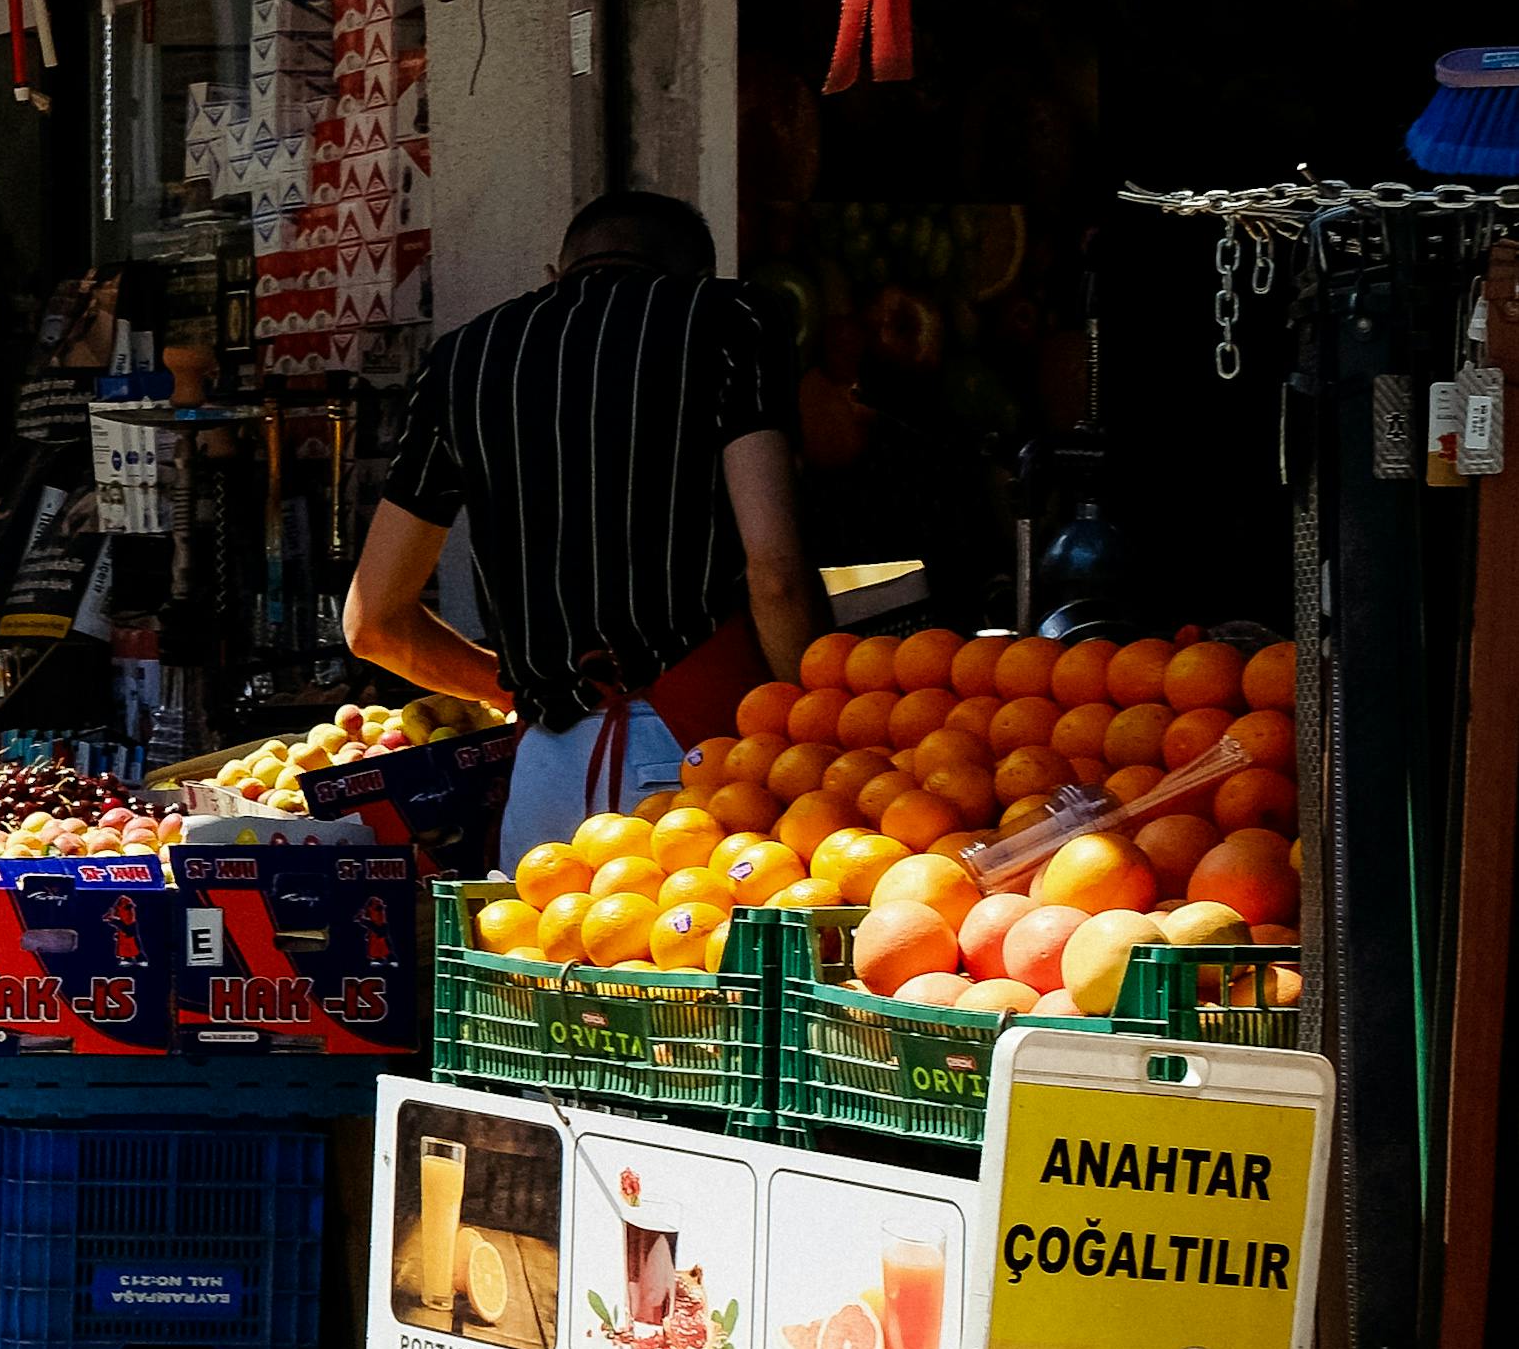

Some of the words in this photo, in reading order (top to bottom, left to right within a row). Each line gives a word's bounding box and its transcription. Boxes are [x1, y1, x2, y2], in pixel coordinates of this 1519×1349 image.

[192, 928, 211, 955] E
[209, 976, 314, 1024] HAK
[1040, 1137, 1271, 1201] ANAHTAR
[1003, 1217, 1289, 1290] ÇOĞALTILIR
